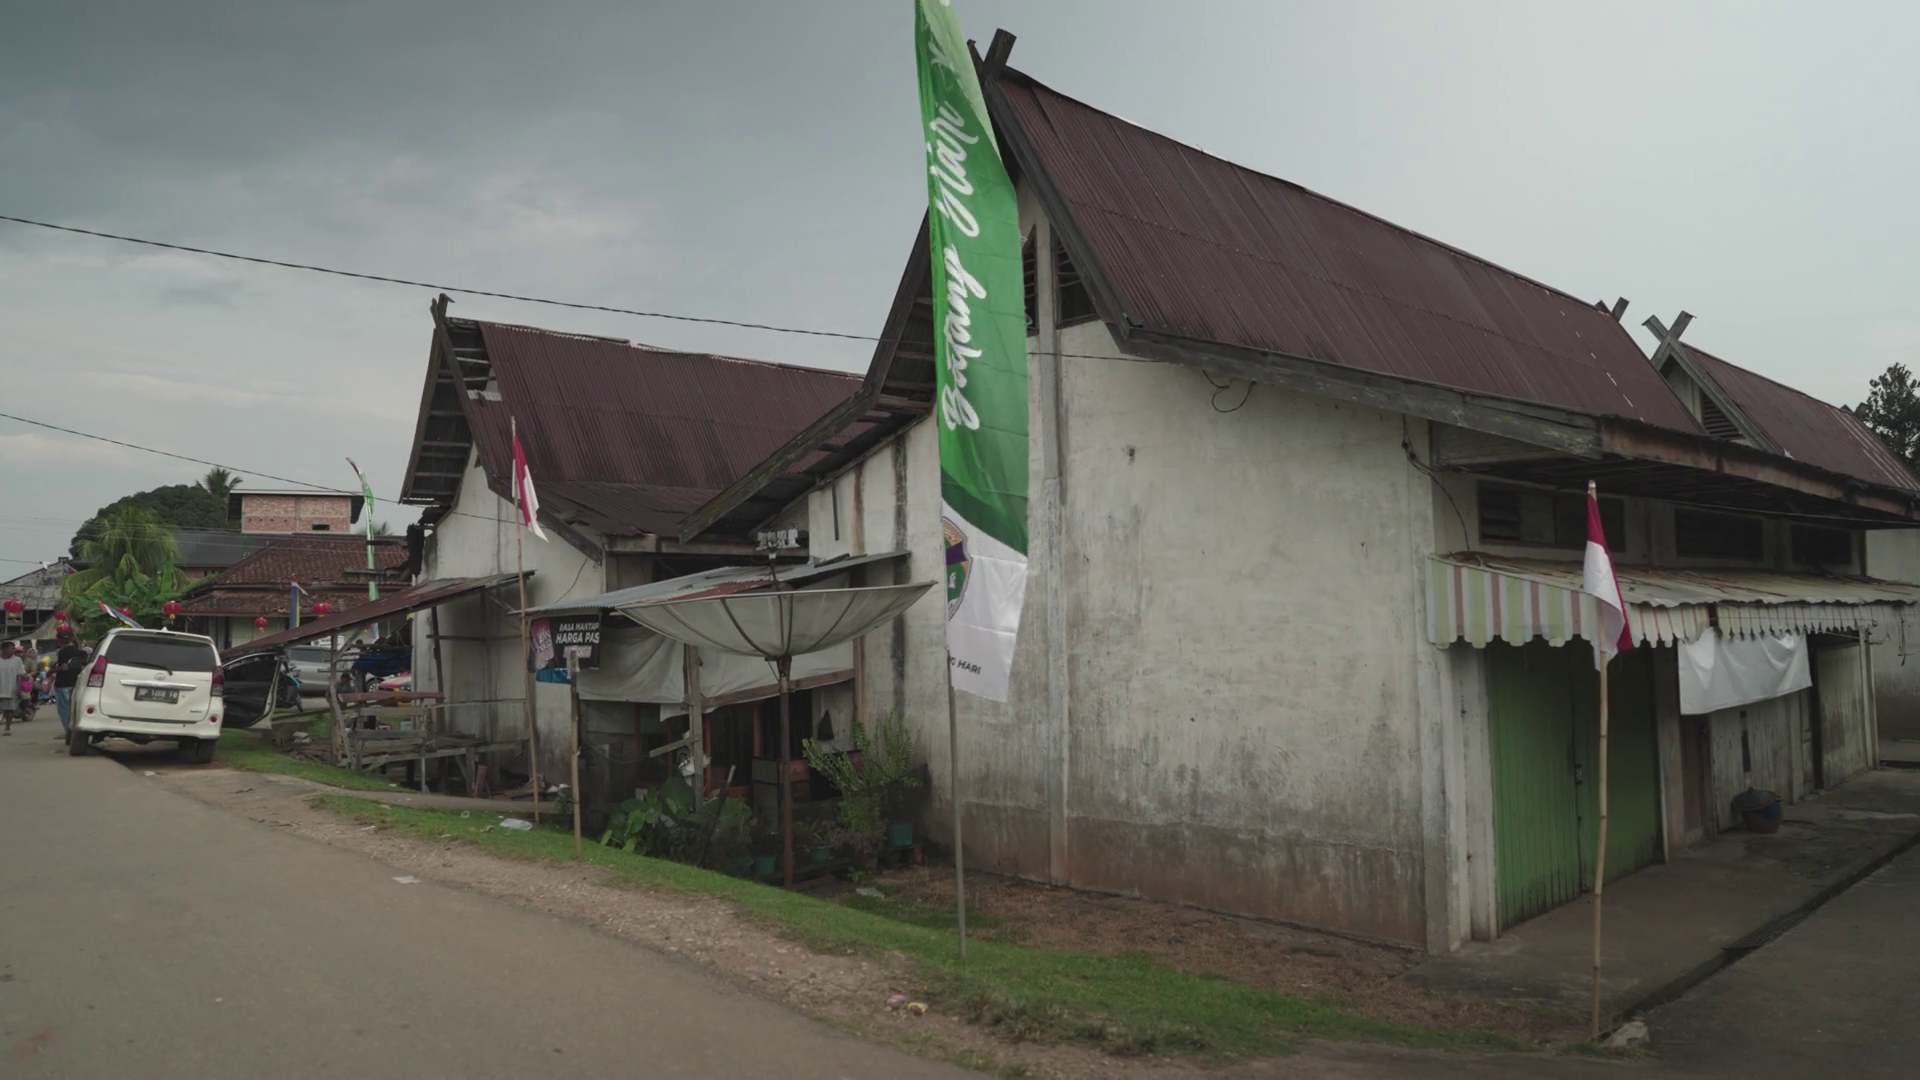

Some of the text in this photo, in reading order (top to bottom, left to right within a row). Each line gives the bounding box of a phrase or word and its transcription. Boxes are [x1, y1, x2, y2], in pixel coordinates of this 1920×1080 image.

[927, 100, 980, 238] Hari
[941, 243, 987, 431] Batang
[559, 622, 600, 632] RASA MANTAP
[555, 632, 583, 644] HARGA
[584, 631, 600, 644] PAS
[957, 659, 982, 675] HARI
